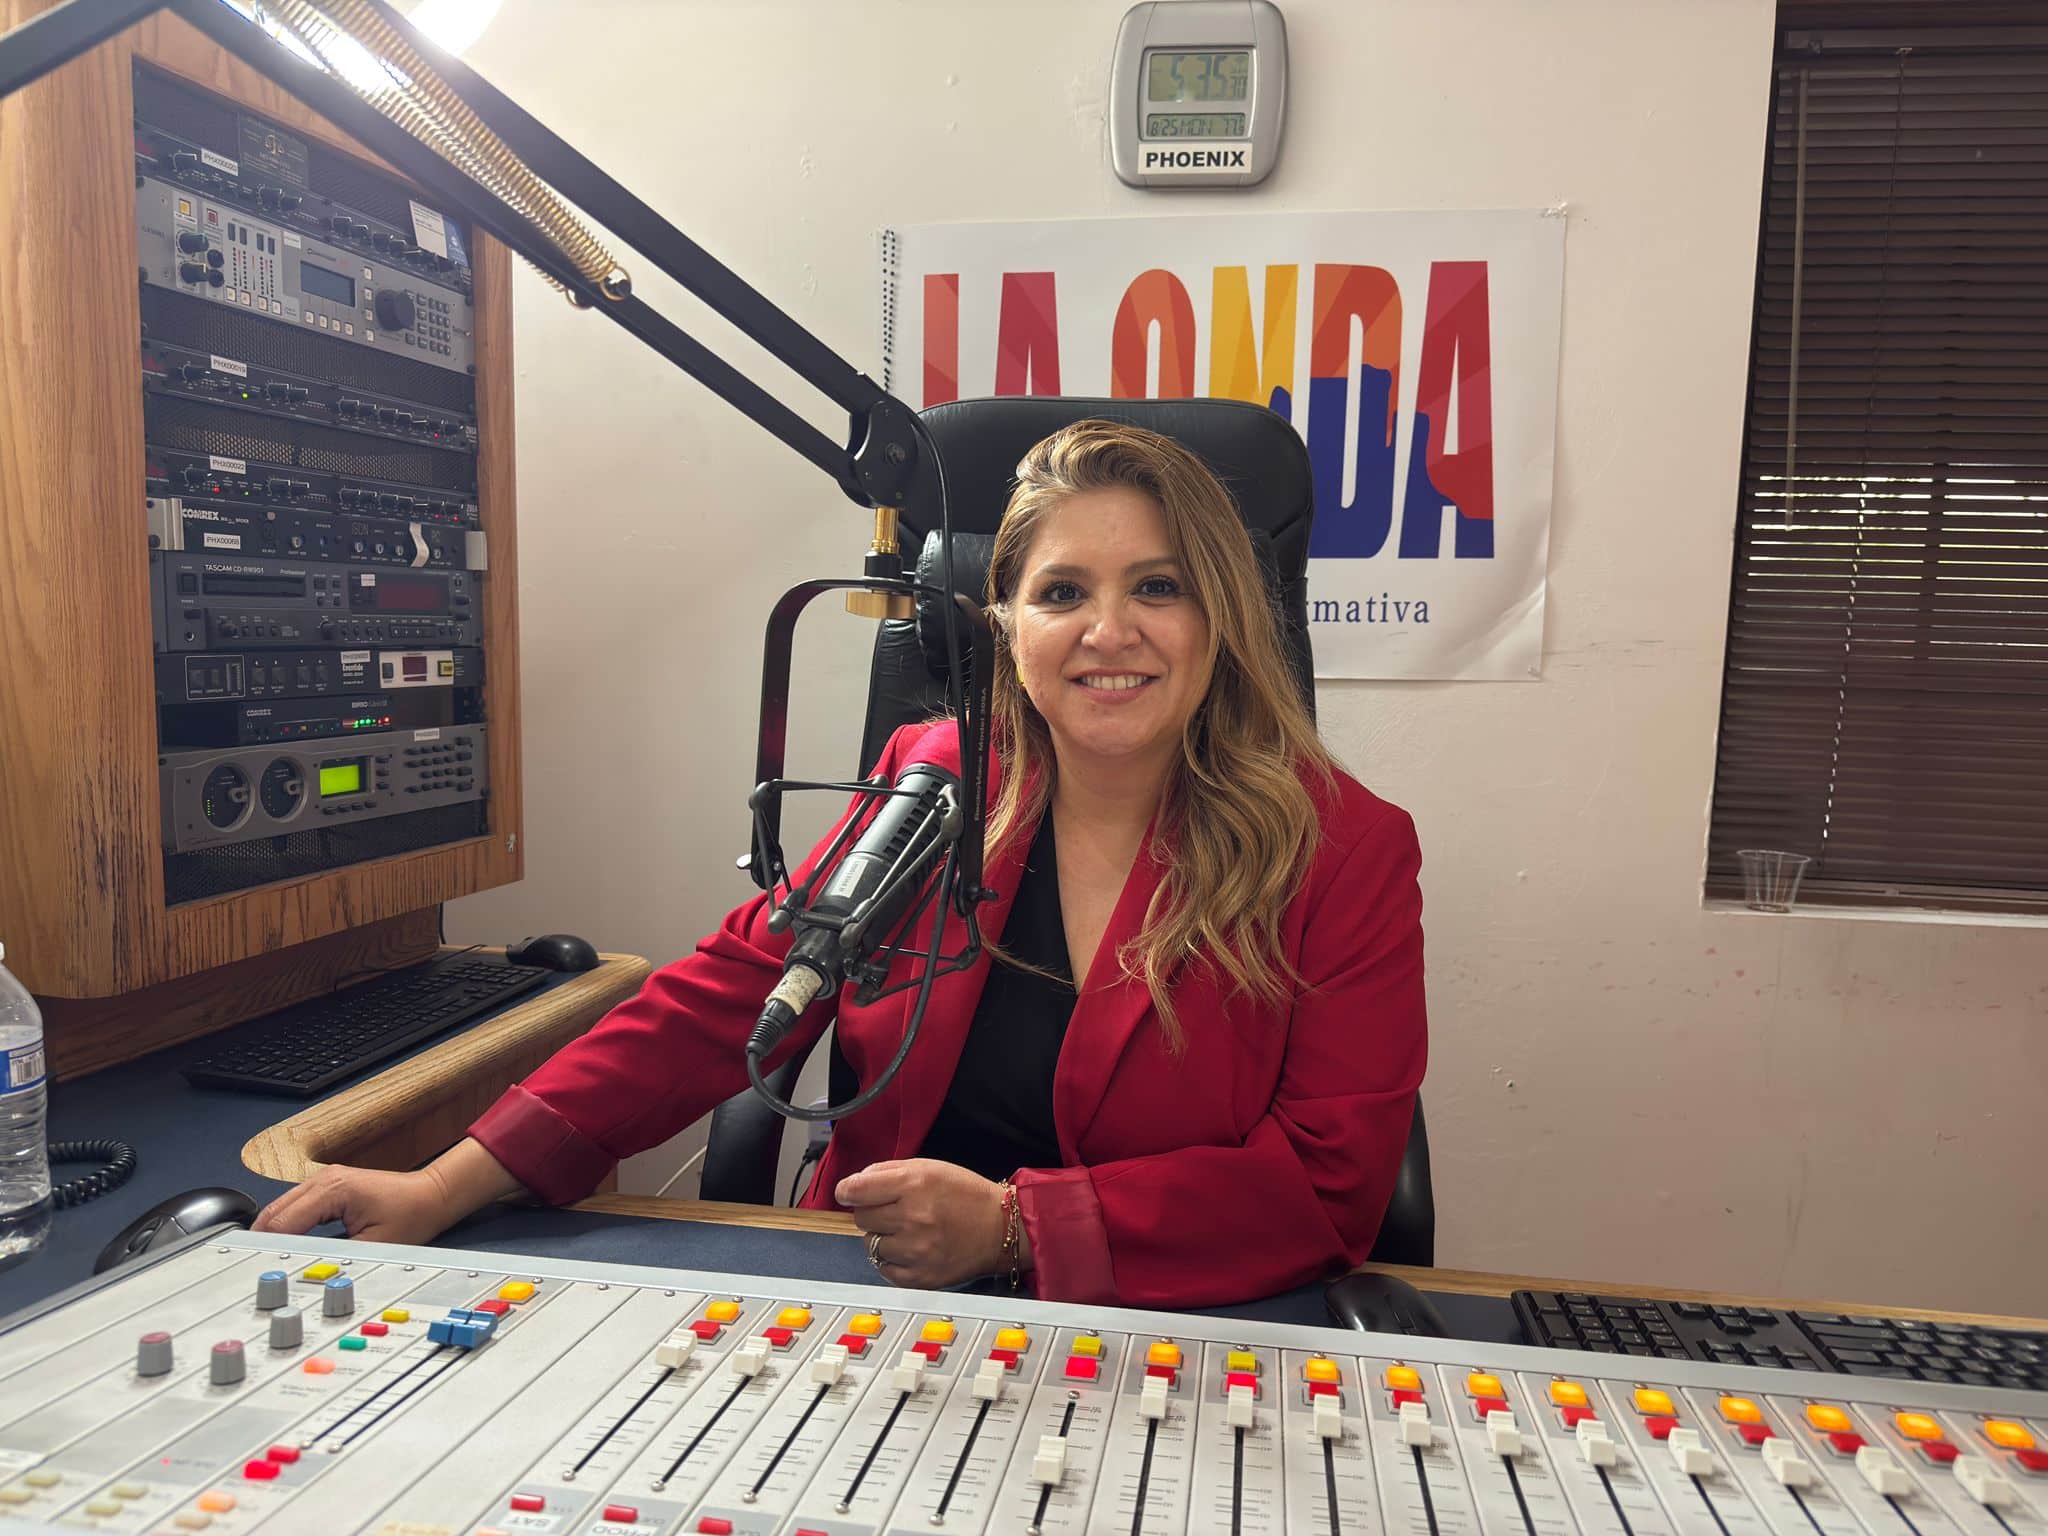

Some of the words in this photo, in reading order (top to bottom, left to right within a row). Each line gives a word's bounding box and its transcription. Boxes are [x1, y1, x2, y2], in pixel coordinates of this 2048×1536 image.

[1146, 151, 1245, 168] PHOENIX
[182, 508, 220, 521] COMREX
[205, 564, 233, 573] TASCAM
[1307, 592, 1430, 624] mativa
[511, 1516, 549, 1528] SAT
